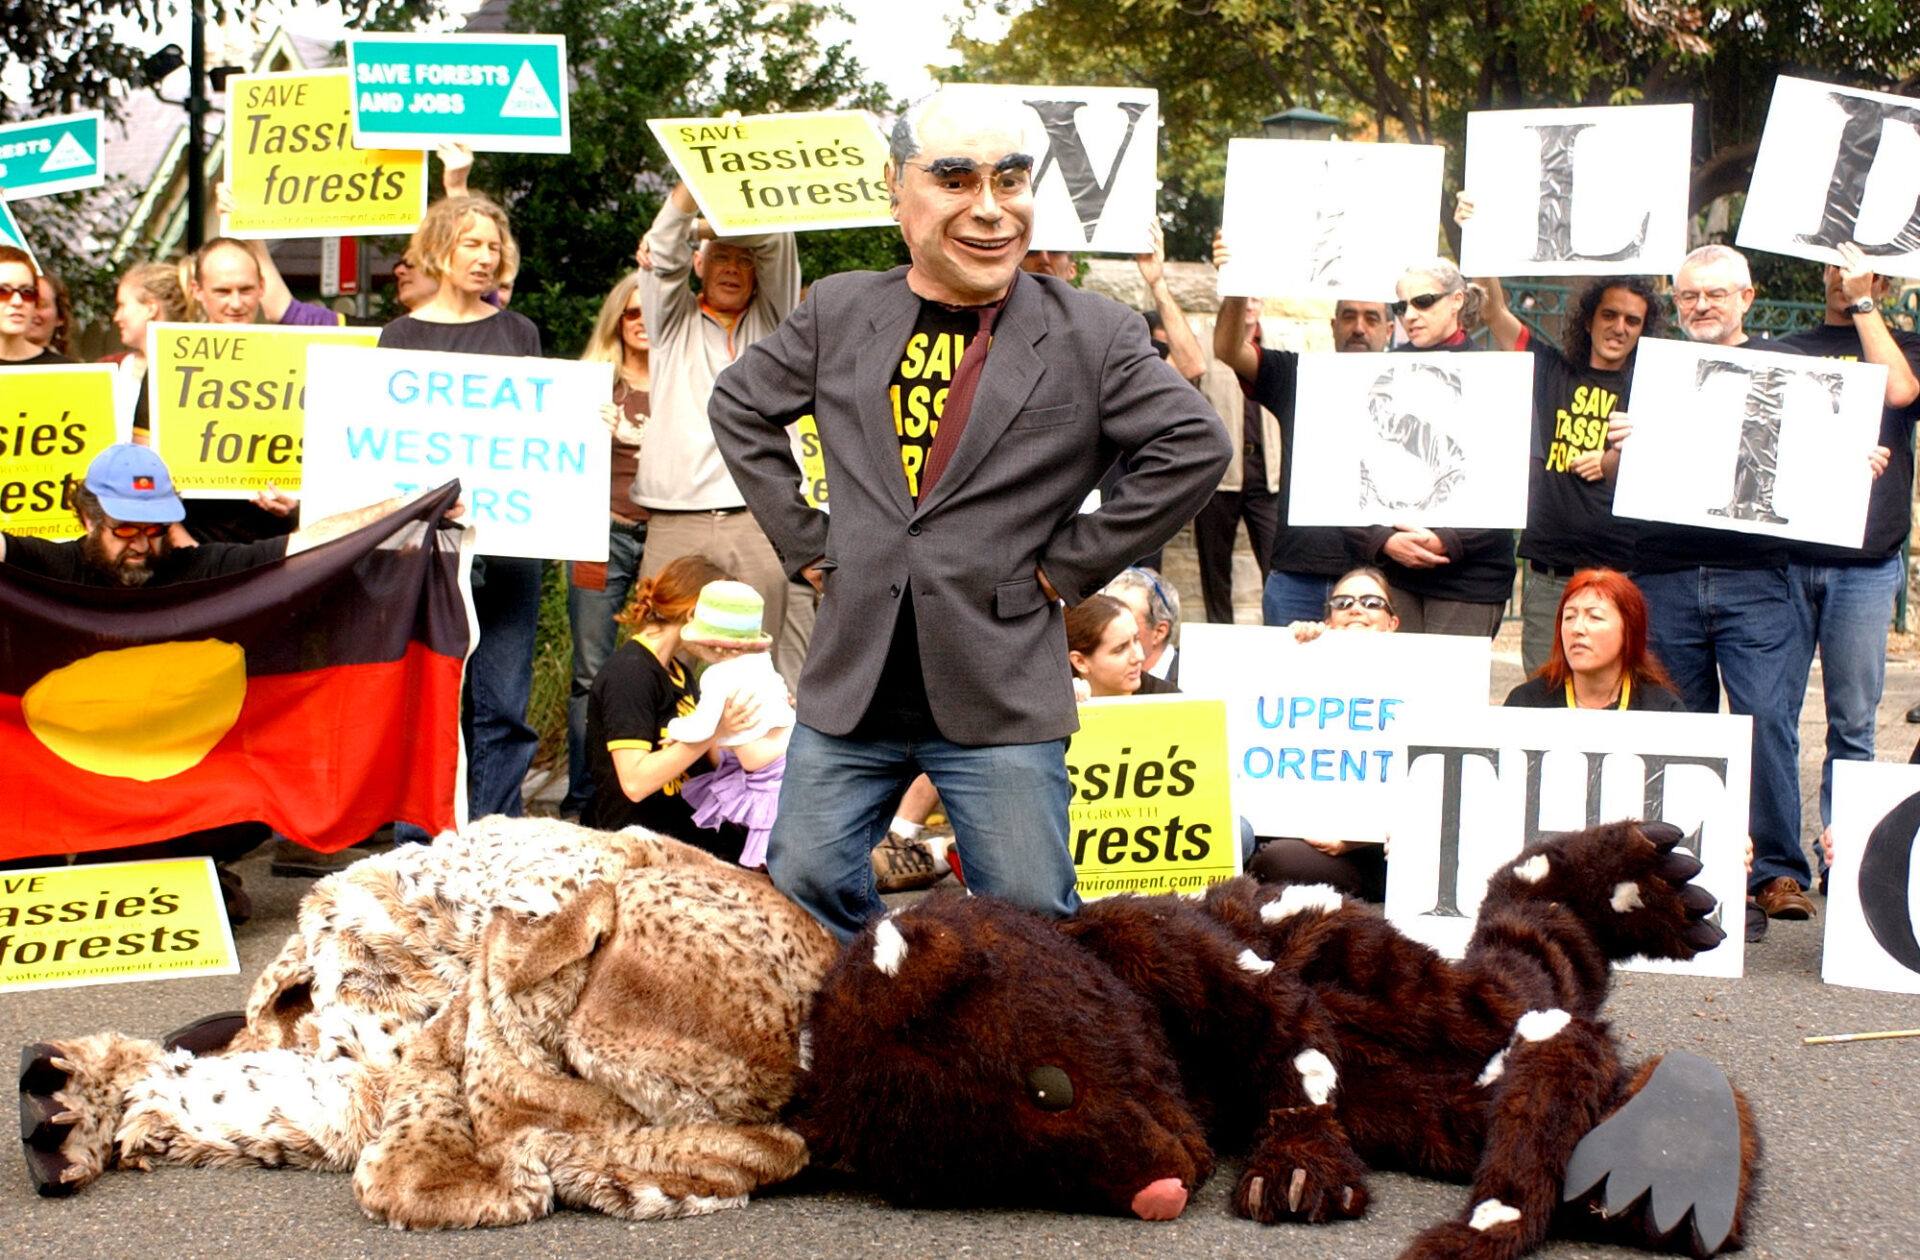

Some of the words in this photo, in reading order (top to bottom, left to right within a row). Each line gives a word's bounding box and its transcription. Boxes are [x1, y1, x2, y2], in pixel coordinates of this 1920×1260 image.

[356, 63, 411, 84] SAVE
[415, 64, 510, 86] FORESTS
[246, 84, 309, 108] SAVE
[359, 92, 404, 113] AND
[408, 93, 465, 114] JOBS
[0, 138, 52, 159] ESTS
[247, 110, 364, 154] Tassi
[680, 125, 748, 143] SAVE
[689, 139, 865, 174] Tassie's
[264, 165, 406, 205] forests
[739, 177, 890, 208] forests
[1524, 124, 1650, 262] L
[173, 336, 247, 360] SAVE
[388, 370, 554, 412] GREAT
[347, 426, 585, 475] WESTERN
[1359, 362, 1465, 510] S
[1696, 358, 1844, 525] T
[394, 483, 532, 524] TRS
[1237, 747, 1394, 783] ORENT
[1074, 816, 1212, 866] rests
